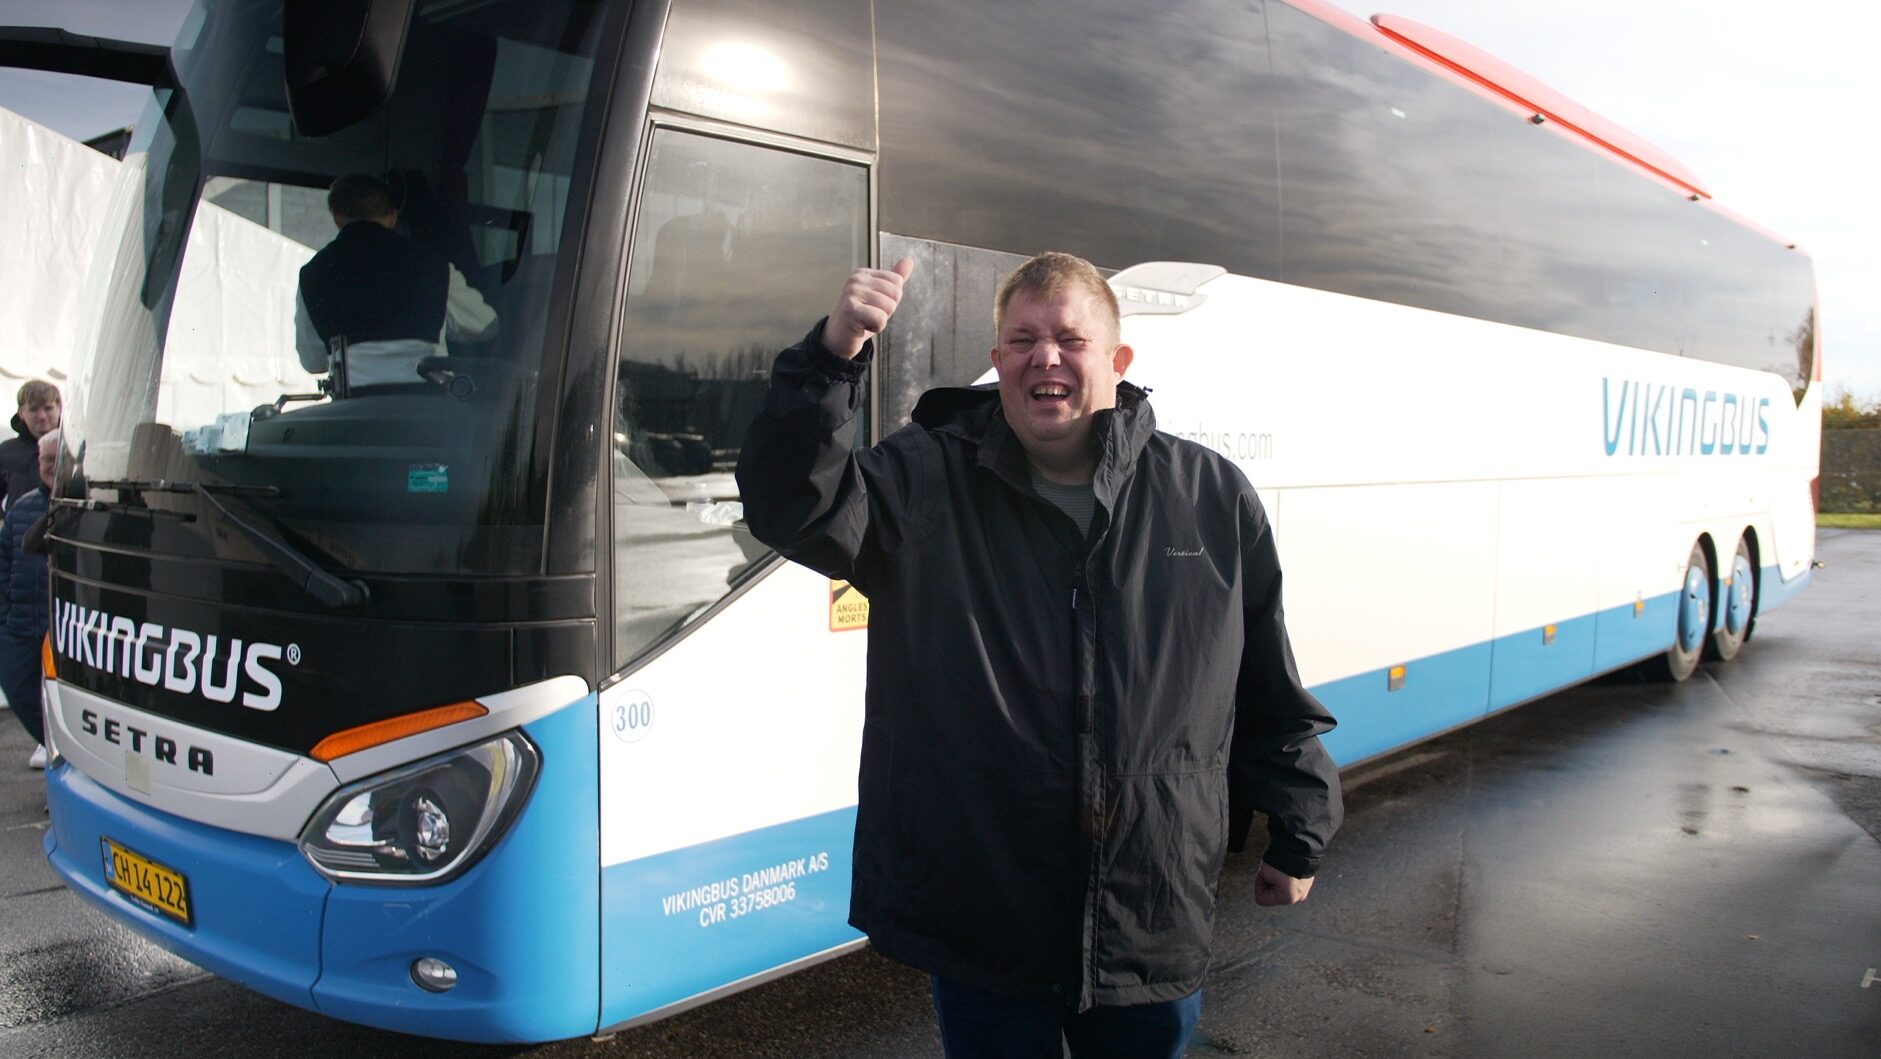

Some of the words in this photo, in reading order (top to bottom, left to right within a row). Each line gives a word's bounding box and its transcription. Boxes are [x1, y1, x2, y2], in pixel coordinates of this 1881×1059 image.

[1602, 377, 1770, 457] VIKINGBUS
[1163, 546, 1205, 557] Vertical
[836, 602, 868, 613] ANGLES
[838, 613, 867, 624] MORTS
[614, 701, 651, 733] 300
[81, 708, 215, 777] SETRA
[113, 851, 131, 886] CH
[133, 863, 152, 897] 14
[155, 872, 185, 912] 122
[662, 877, 740, 917] VIKINGBUS
[743, 858, 806, 893] DANMARK
[808, 851, 829, 874] A/S
[700, 902, 727, 928] CVR
[730, 881, 796, 919] 33758006
